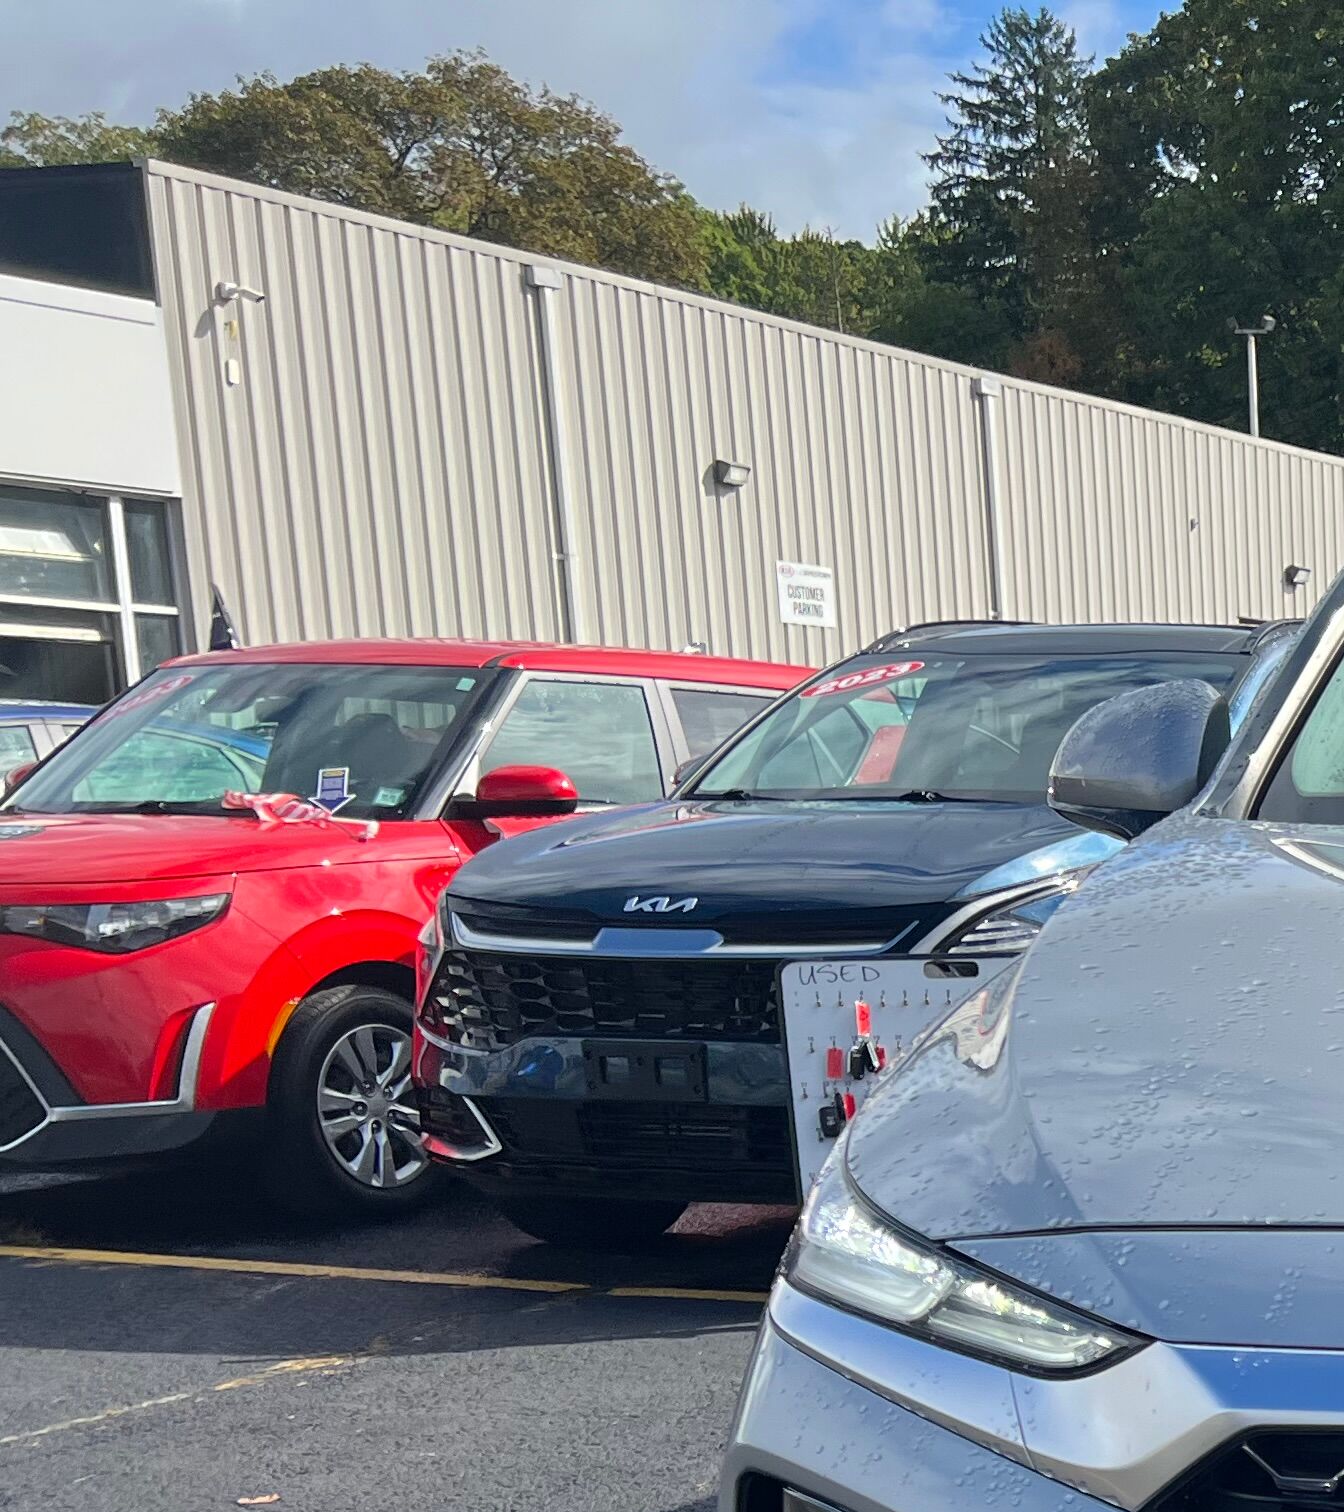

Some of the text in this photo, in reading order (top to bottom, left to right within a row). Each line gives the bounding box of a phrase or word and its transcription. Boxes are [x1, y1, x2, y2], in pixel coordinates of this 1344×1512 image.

[787, 584, 825, 602] CUSTOMER
[793, 601, 824, 618] PARKING
[811, 662, 911, 696] 2023
[623, 896, 698, 913] KIA
[799, 964, 880, 985] USED
